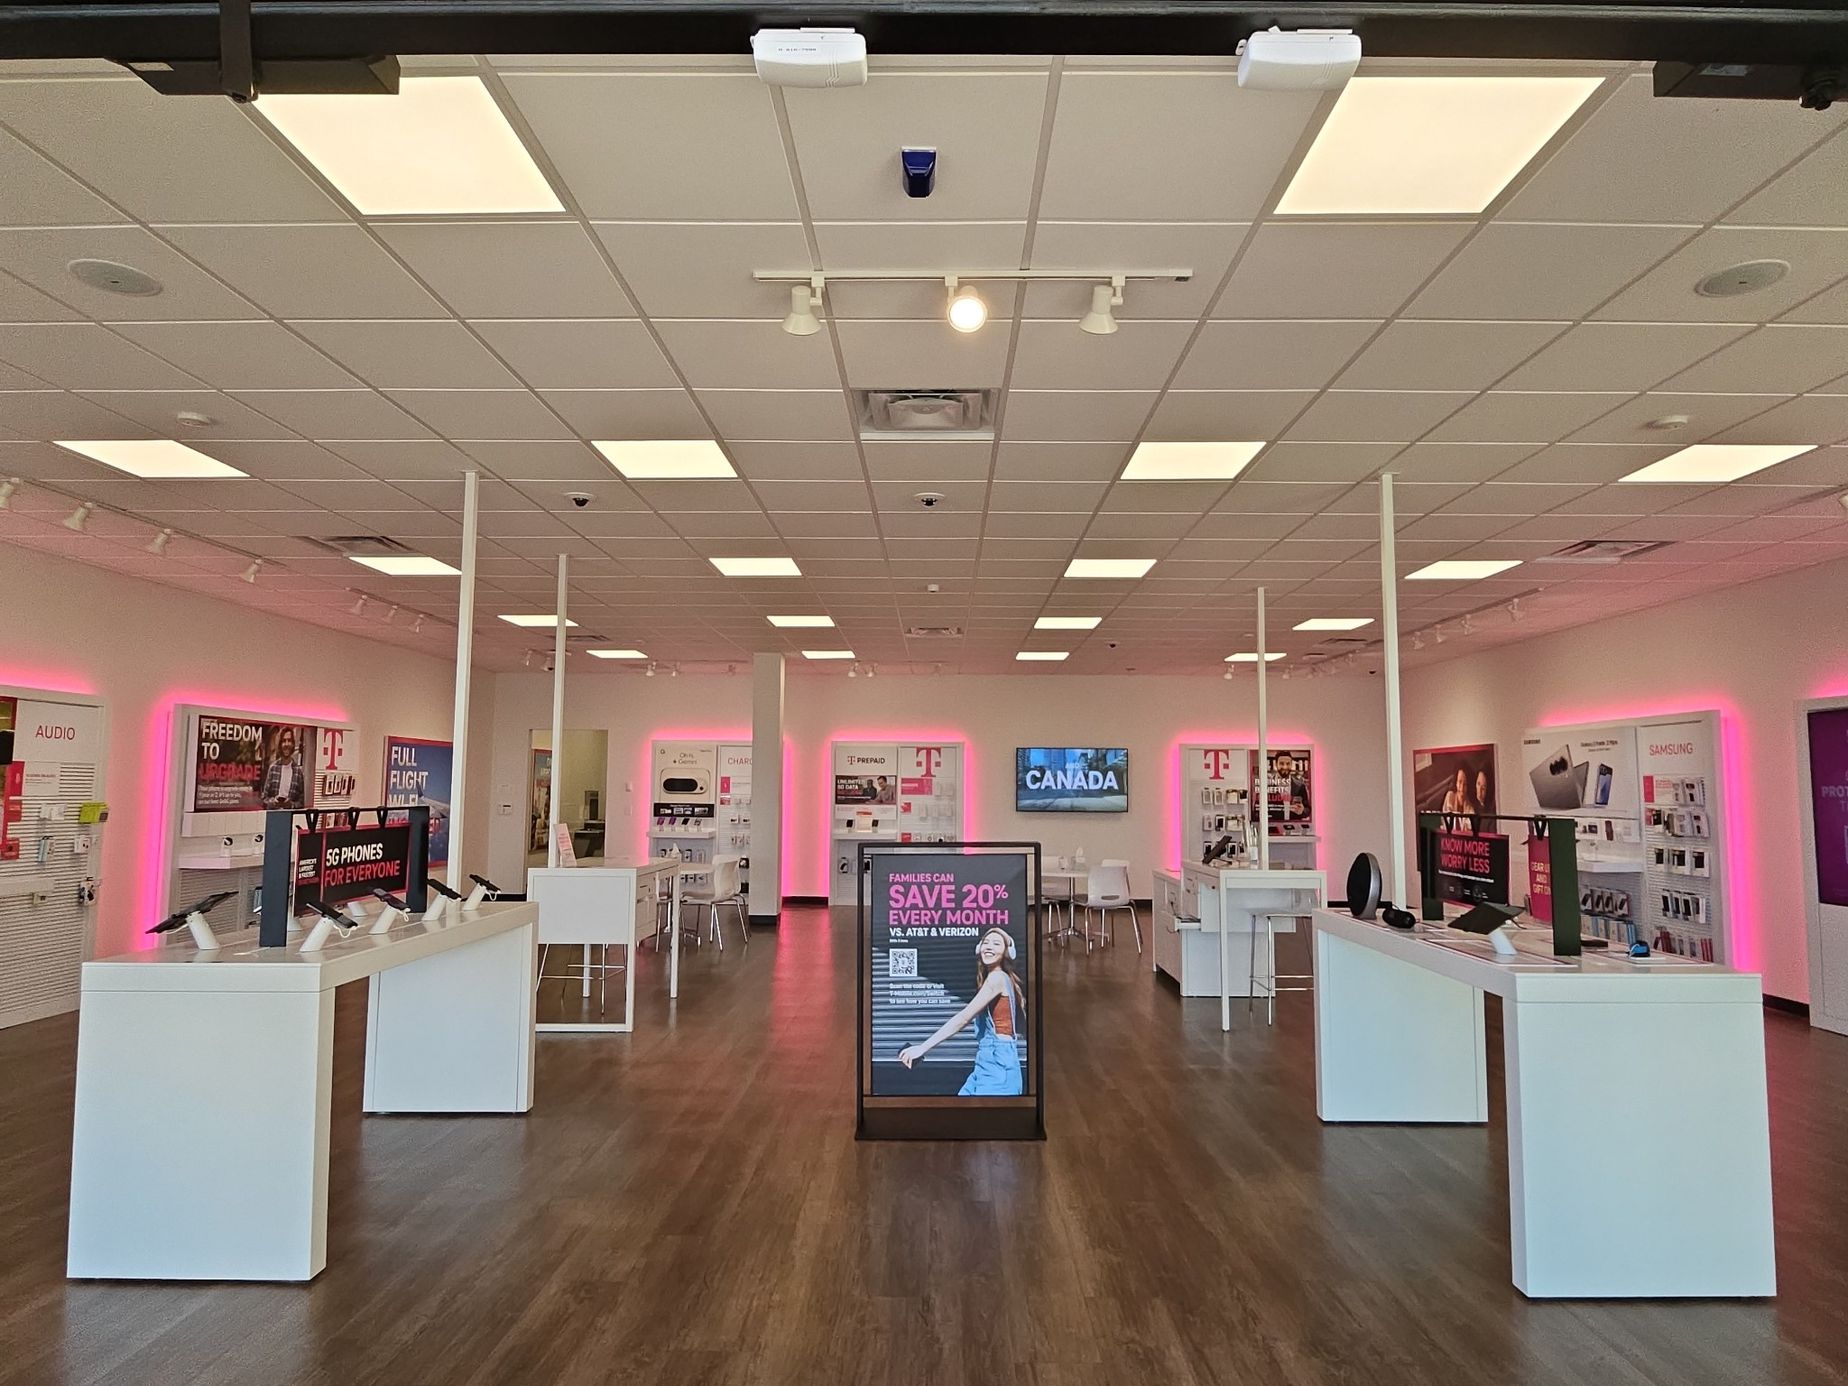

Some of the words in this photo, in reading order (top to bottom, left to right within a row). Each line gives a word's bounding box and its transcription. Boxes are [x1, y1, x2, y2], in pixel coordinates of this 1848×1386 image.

[35, 725, 76, 741] AUDIO
[201, 721, 263, 742] FREEDOM
[201, 742, 220, 760] TO
[391, 746, 417, 767] FULL
[1649, 742, 1694, 756] SAMSUNG
[856, 757, 886, 765] PREPAID
[389, 770, 429, 790] FLIGHT
[1025, 769, 1119, 790] CANADA
[326, 848, 340, 867] 5G
[340, 842, 383, 864] PHONES
[1440, 838, 1463, 852] KNOW
[1464, 841, 1490, 856] MORE
[325, 868, 345, 887] FOR
[345, 860, 401, 884] EVERYONE
[1440, 854, 1466, 870] WORRY
[1468, 858, 1490, 874] LESS
[889, 873, 932, 882] FAMILIES
[933, 873, 954, 882] CAN
[889, 884, 956, 908] SAVE
[962, 884, 1009, 908] 20%
[889, 910, 942, 925] EVERY
[946, 910, 1009, 925] MONTH
[889, 928, 904, 936] VS.
[905, 928, 929, 936] AT&T
[930, 928, 938, 936] &
[938, 928, 979, 936] VERIZON
